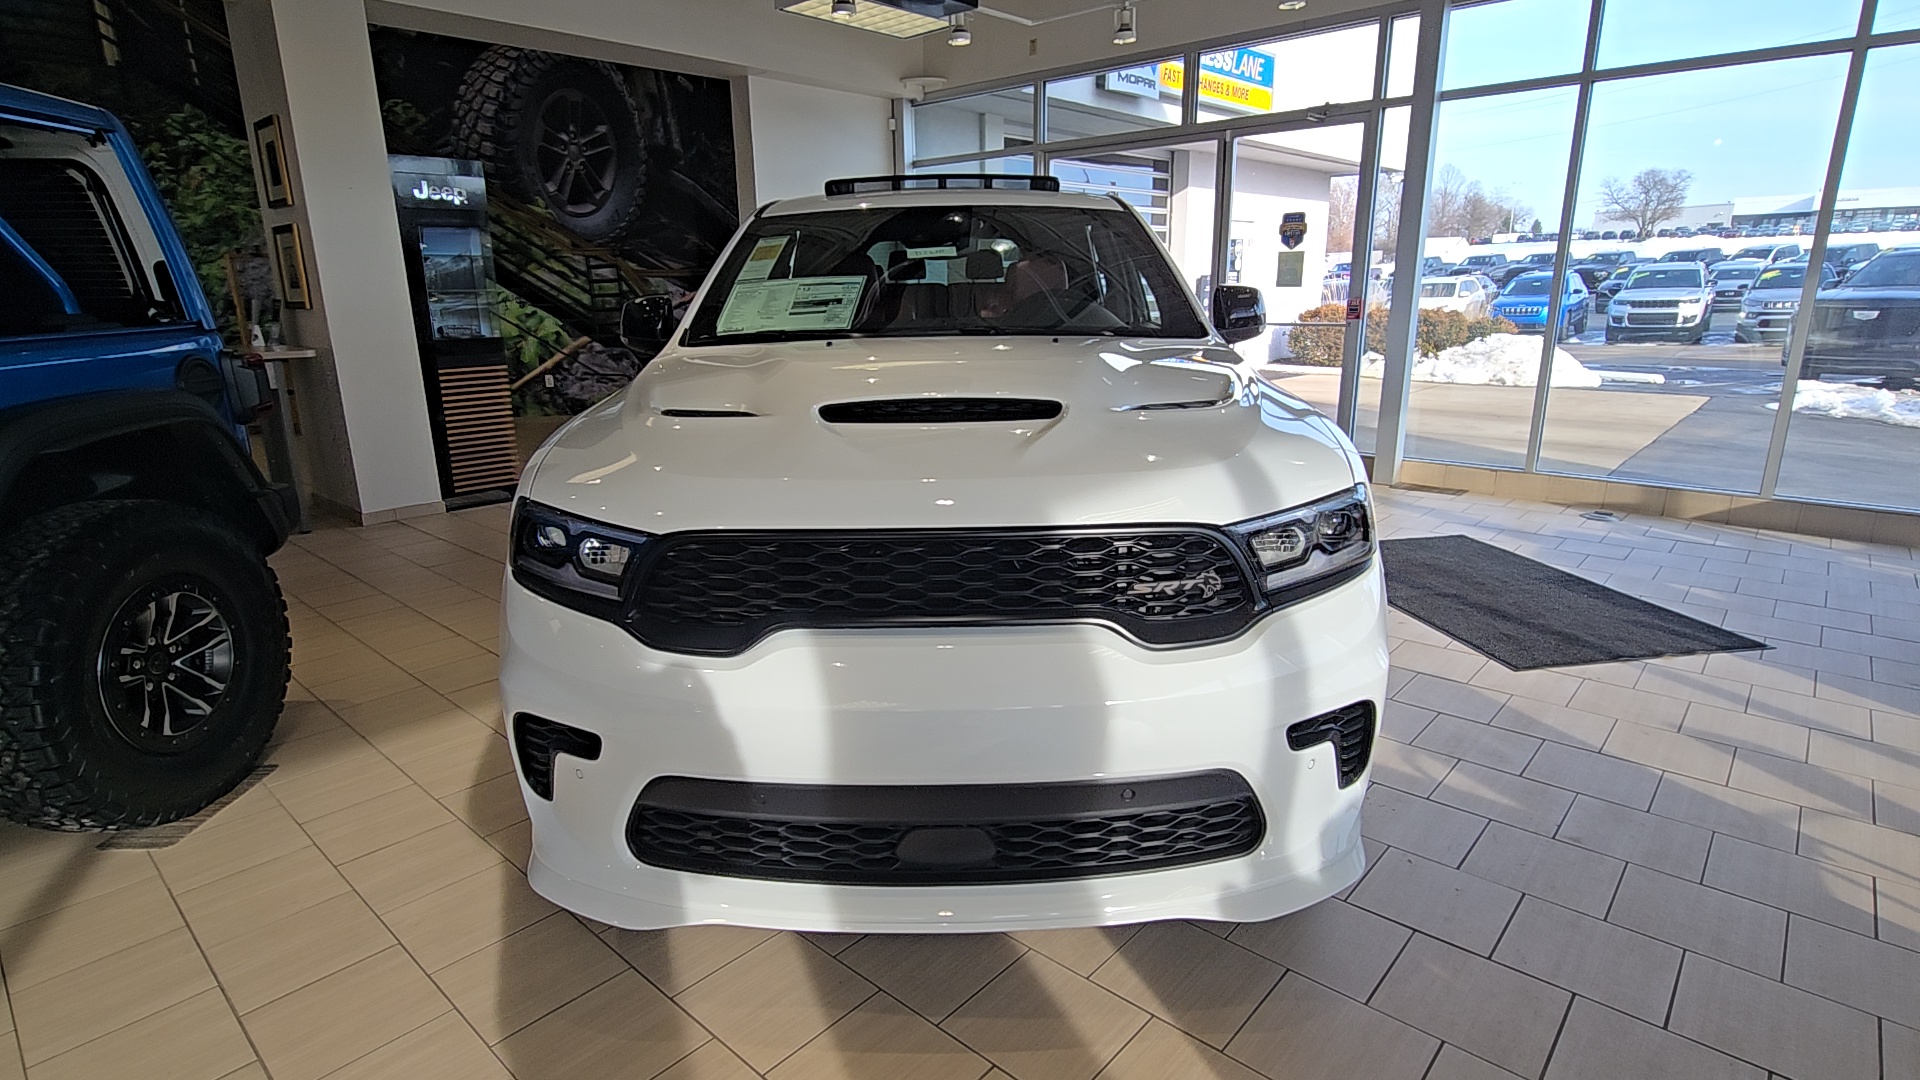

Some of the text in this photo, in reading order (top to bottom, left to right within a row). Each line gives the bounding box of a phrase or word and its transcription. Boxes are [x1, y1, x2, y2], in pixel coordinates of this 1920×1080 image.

[1117, 71, 1157, 91] MOPAR
[1163, 67, 1181, 84] FAST
[1225, 84, 1230, 97] &
[1232, 85, 1250, 101] MORE
[412, 180, 468, 206] Jeep
[1127, 579, 1204, 596] SRT
